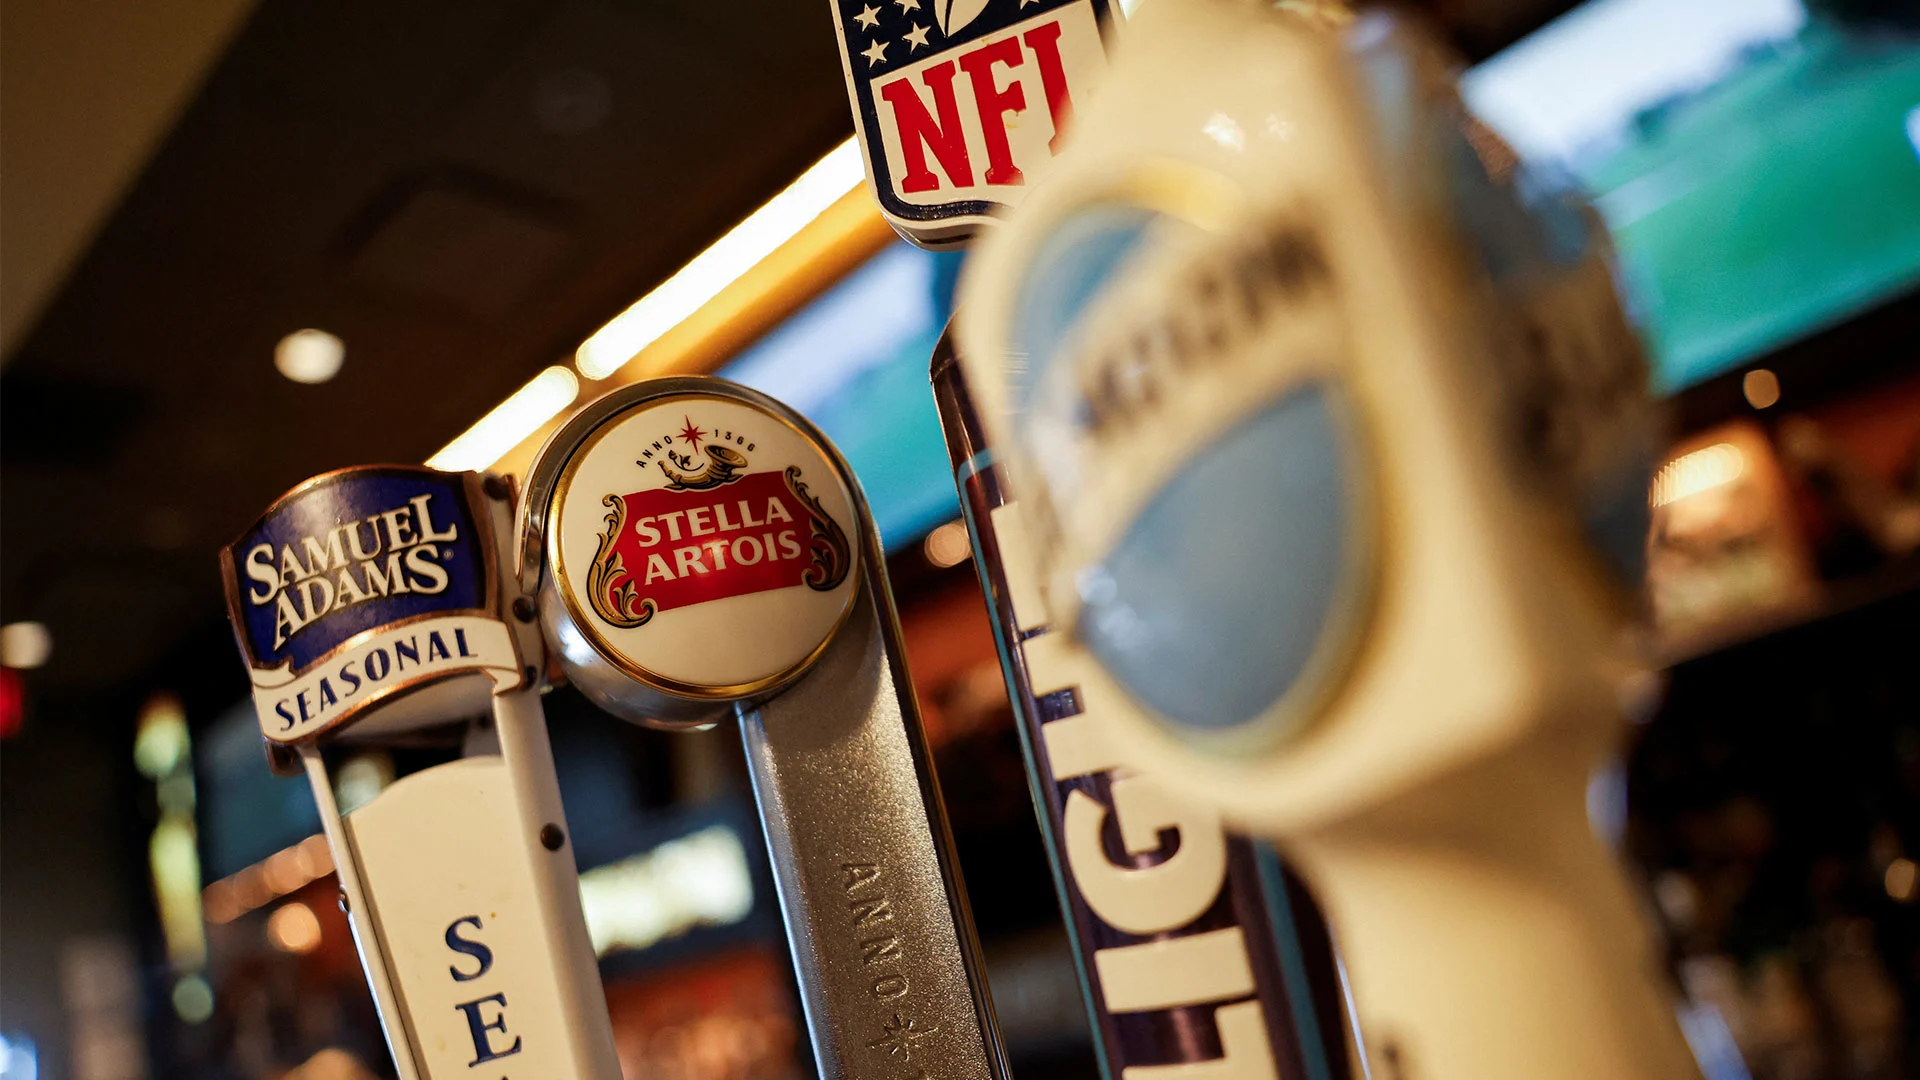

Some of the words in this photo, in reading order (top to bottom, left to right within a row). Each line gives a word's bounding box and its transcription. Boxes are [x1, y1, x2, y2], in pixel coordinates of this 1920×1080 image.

[636, 435, 672, 468] ANNO
[714, 428, 756, 452] 1366
[246, 494, 458, 605] SAMUEL
[635, 496, 794, 548] STELLA
[644, 530, 801, 586] ARTOIS
[274, 628, 479, 732] SEASONAL
[841, 863, 909, 1000] ANNO
[445, 914, 523, 1080] SE
